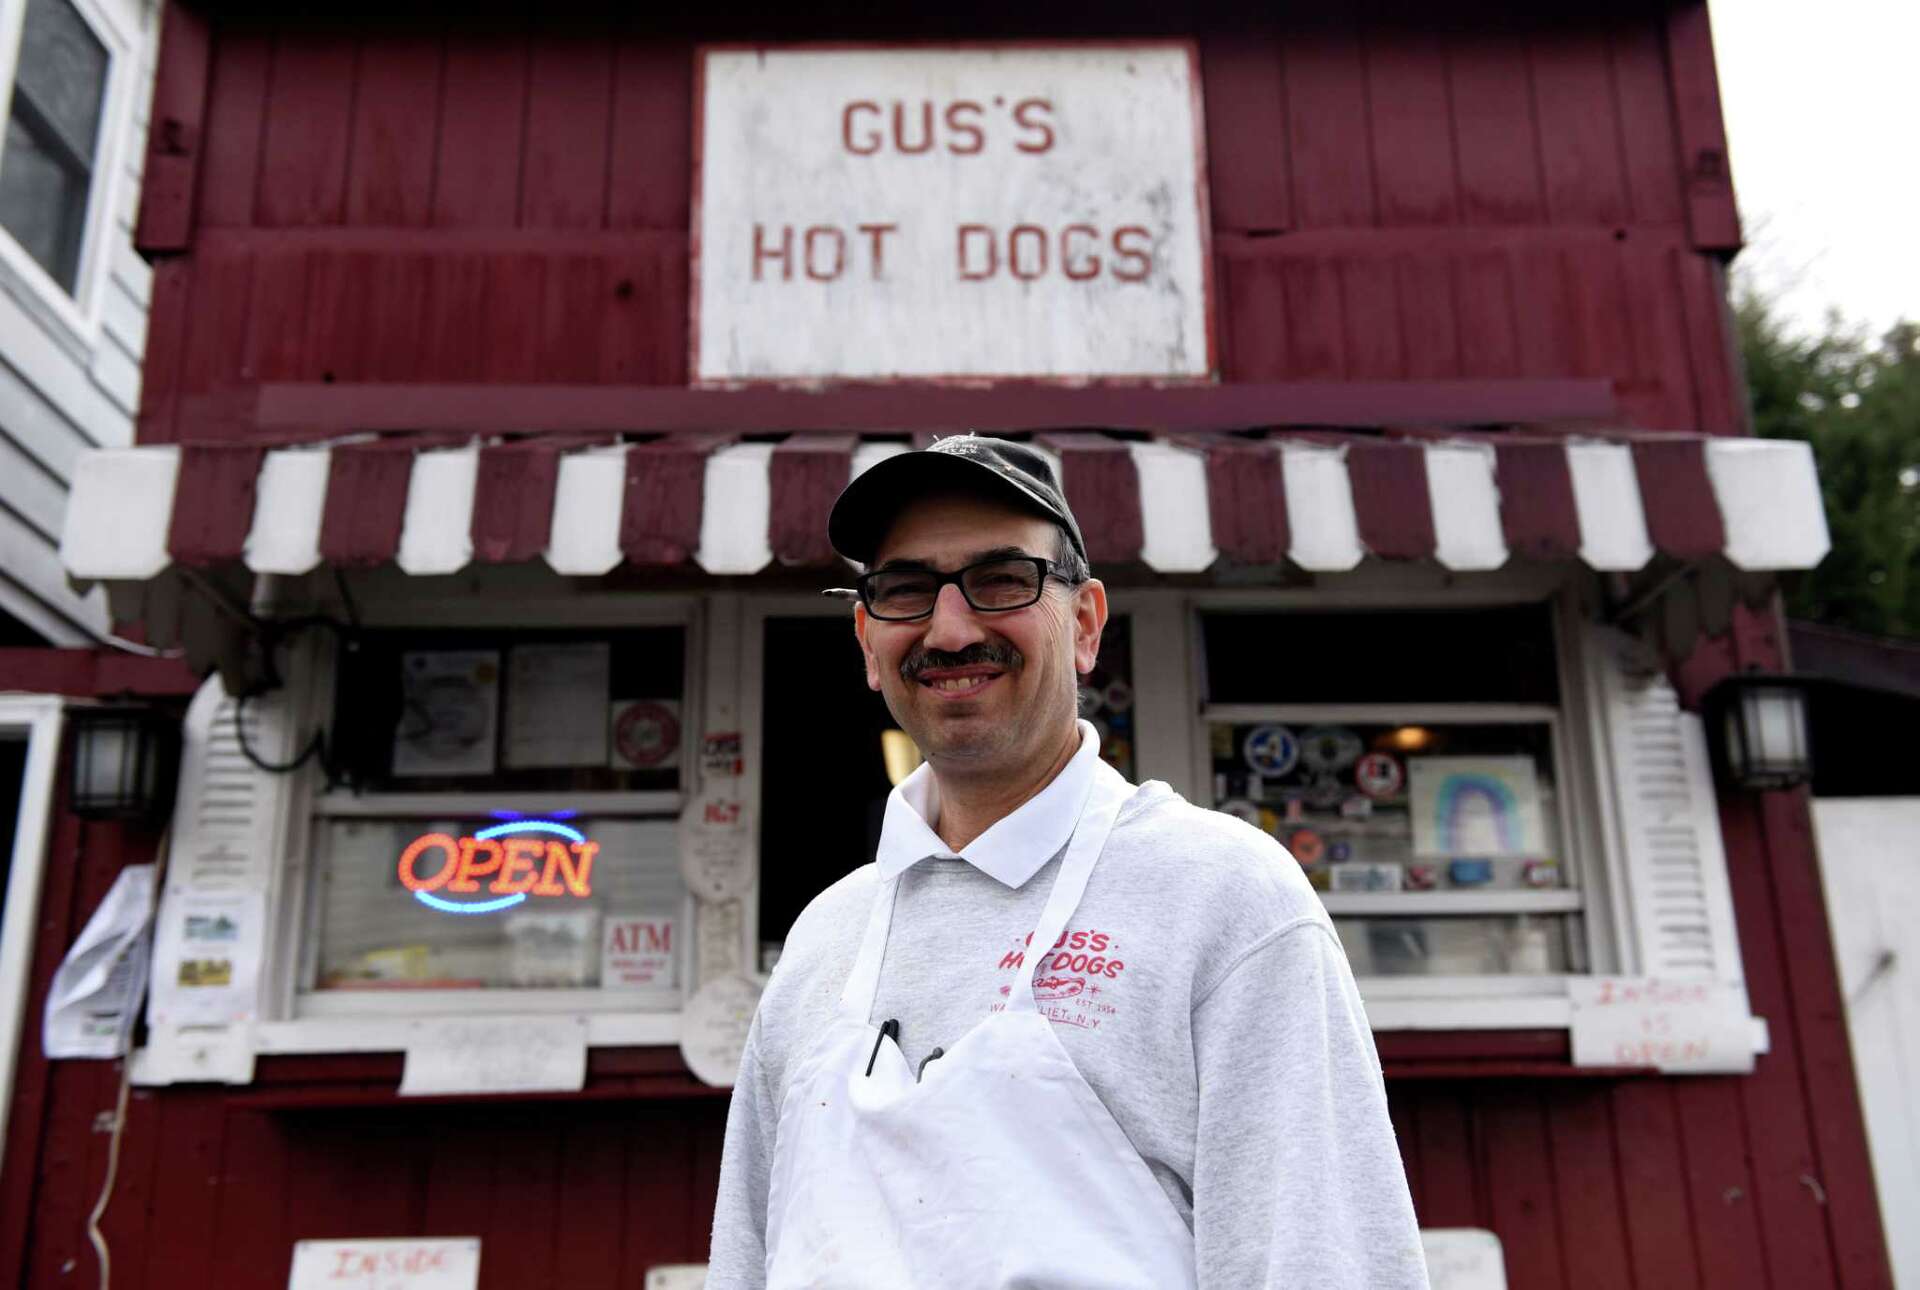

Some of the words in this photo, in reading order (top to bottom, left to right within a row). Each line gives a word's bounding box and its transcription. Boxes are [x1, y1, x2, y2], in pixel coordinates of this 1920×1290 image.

[841, 96, 1056, 156] GUS'S
[751, 222, 898, 282] HOT
[956, 223, 1154, 283] DOGS
[398, 832, 600, 898] OPEN
[608, 922, 674, 954] ATM
[1025, 929, 1111, 952] US'S
[1051, 952, 1124, 979] DOGS
